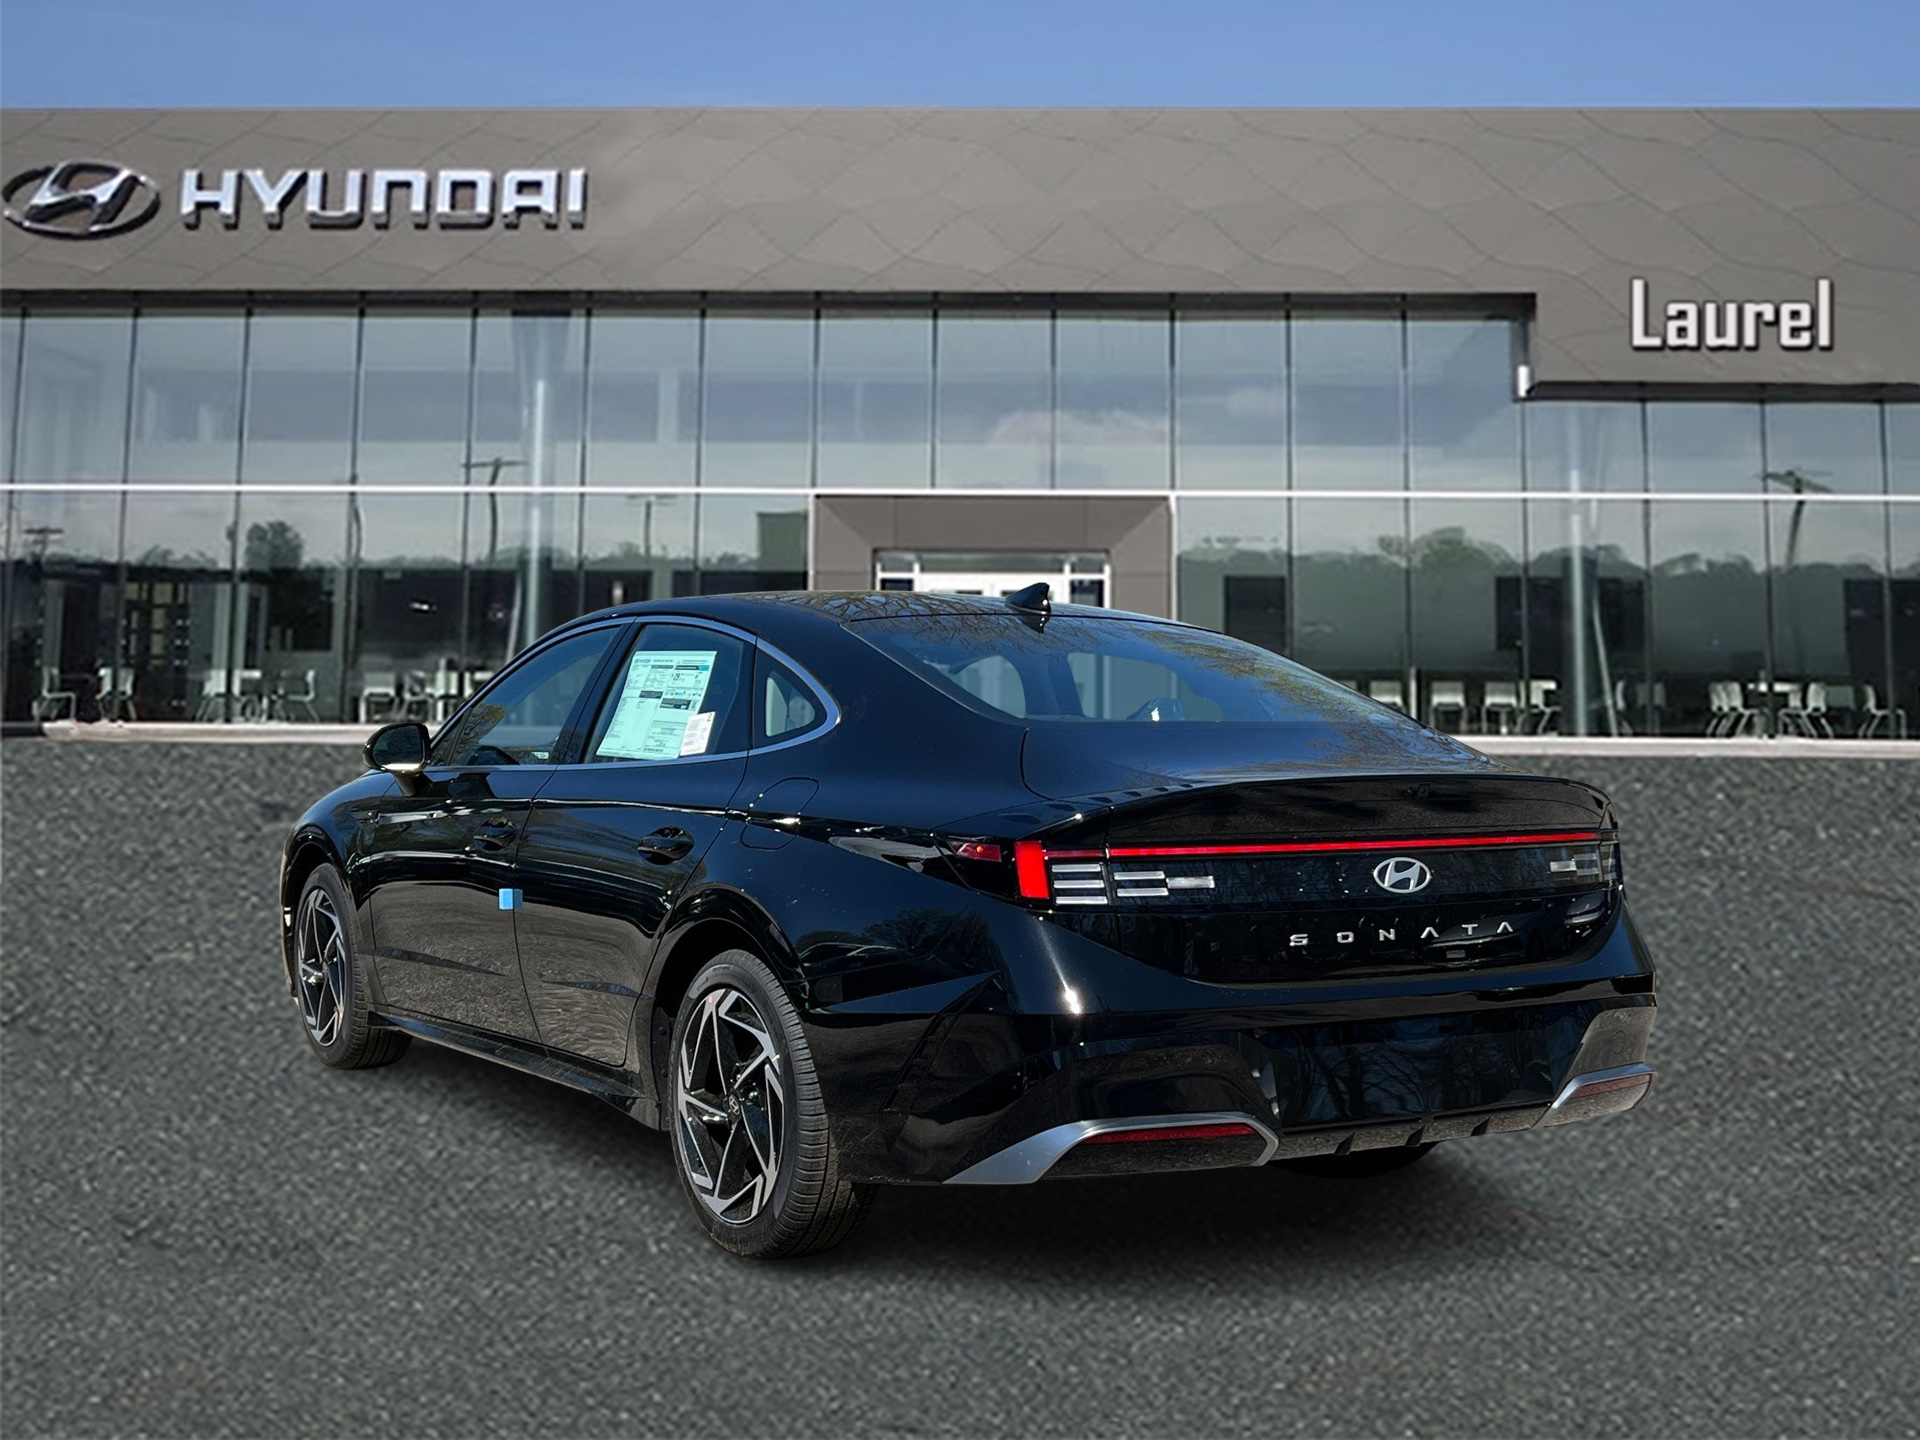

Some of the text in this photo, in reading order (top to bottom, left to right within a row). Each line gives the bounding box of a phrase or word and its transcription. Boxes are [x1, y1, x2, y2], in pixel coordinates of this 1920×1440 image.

[180, 168, 587, 230] HYUNDAI
[1631, 278, 1833, 348] Laurel
[1289, 921, 1513, 947] SONATA
